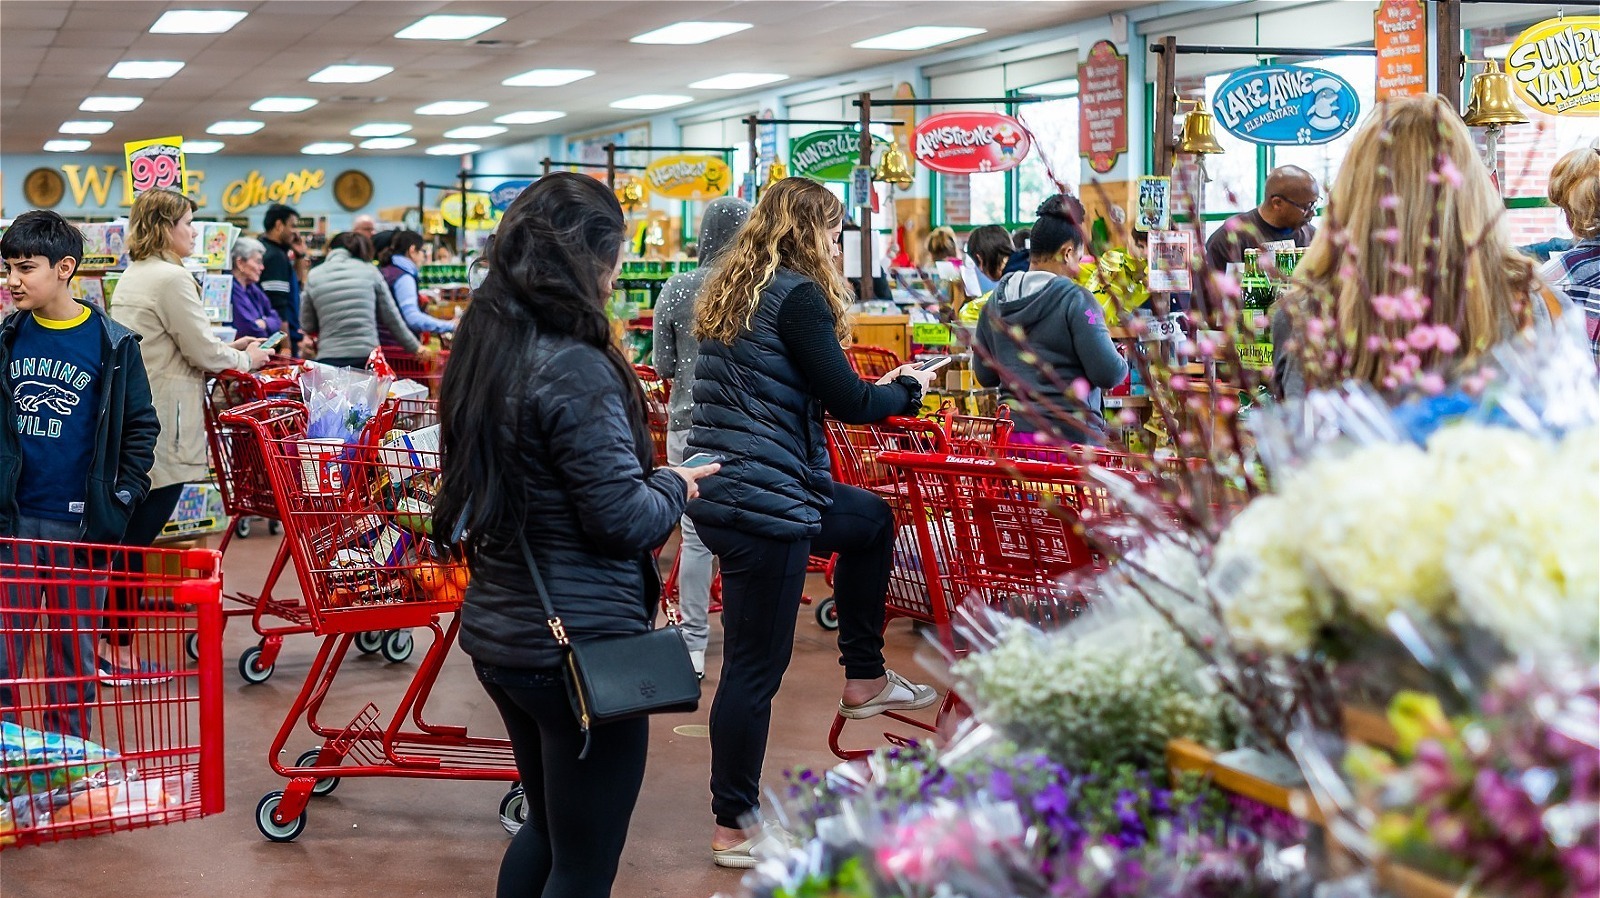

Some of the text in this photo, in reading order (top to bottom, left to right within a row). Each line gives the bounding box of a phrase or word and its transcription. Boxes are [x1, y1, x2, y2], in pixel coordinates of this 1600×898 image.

[1215, 70, 1314, 129] LAKE ANNE
[1244, 105, 1300, 132] ELEMENTARY
[916, 125, 993, 160] ARMSTRONG
[223, 168, 326, 214] Shoppe
[10, 357, 91, 391] UNNING
